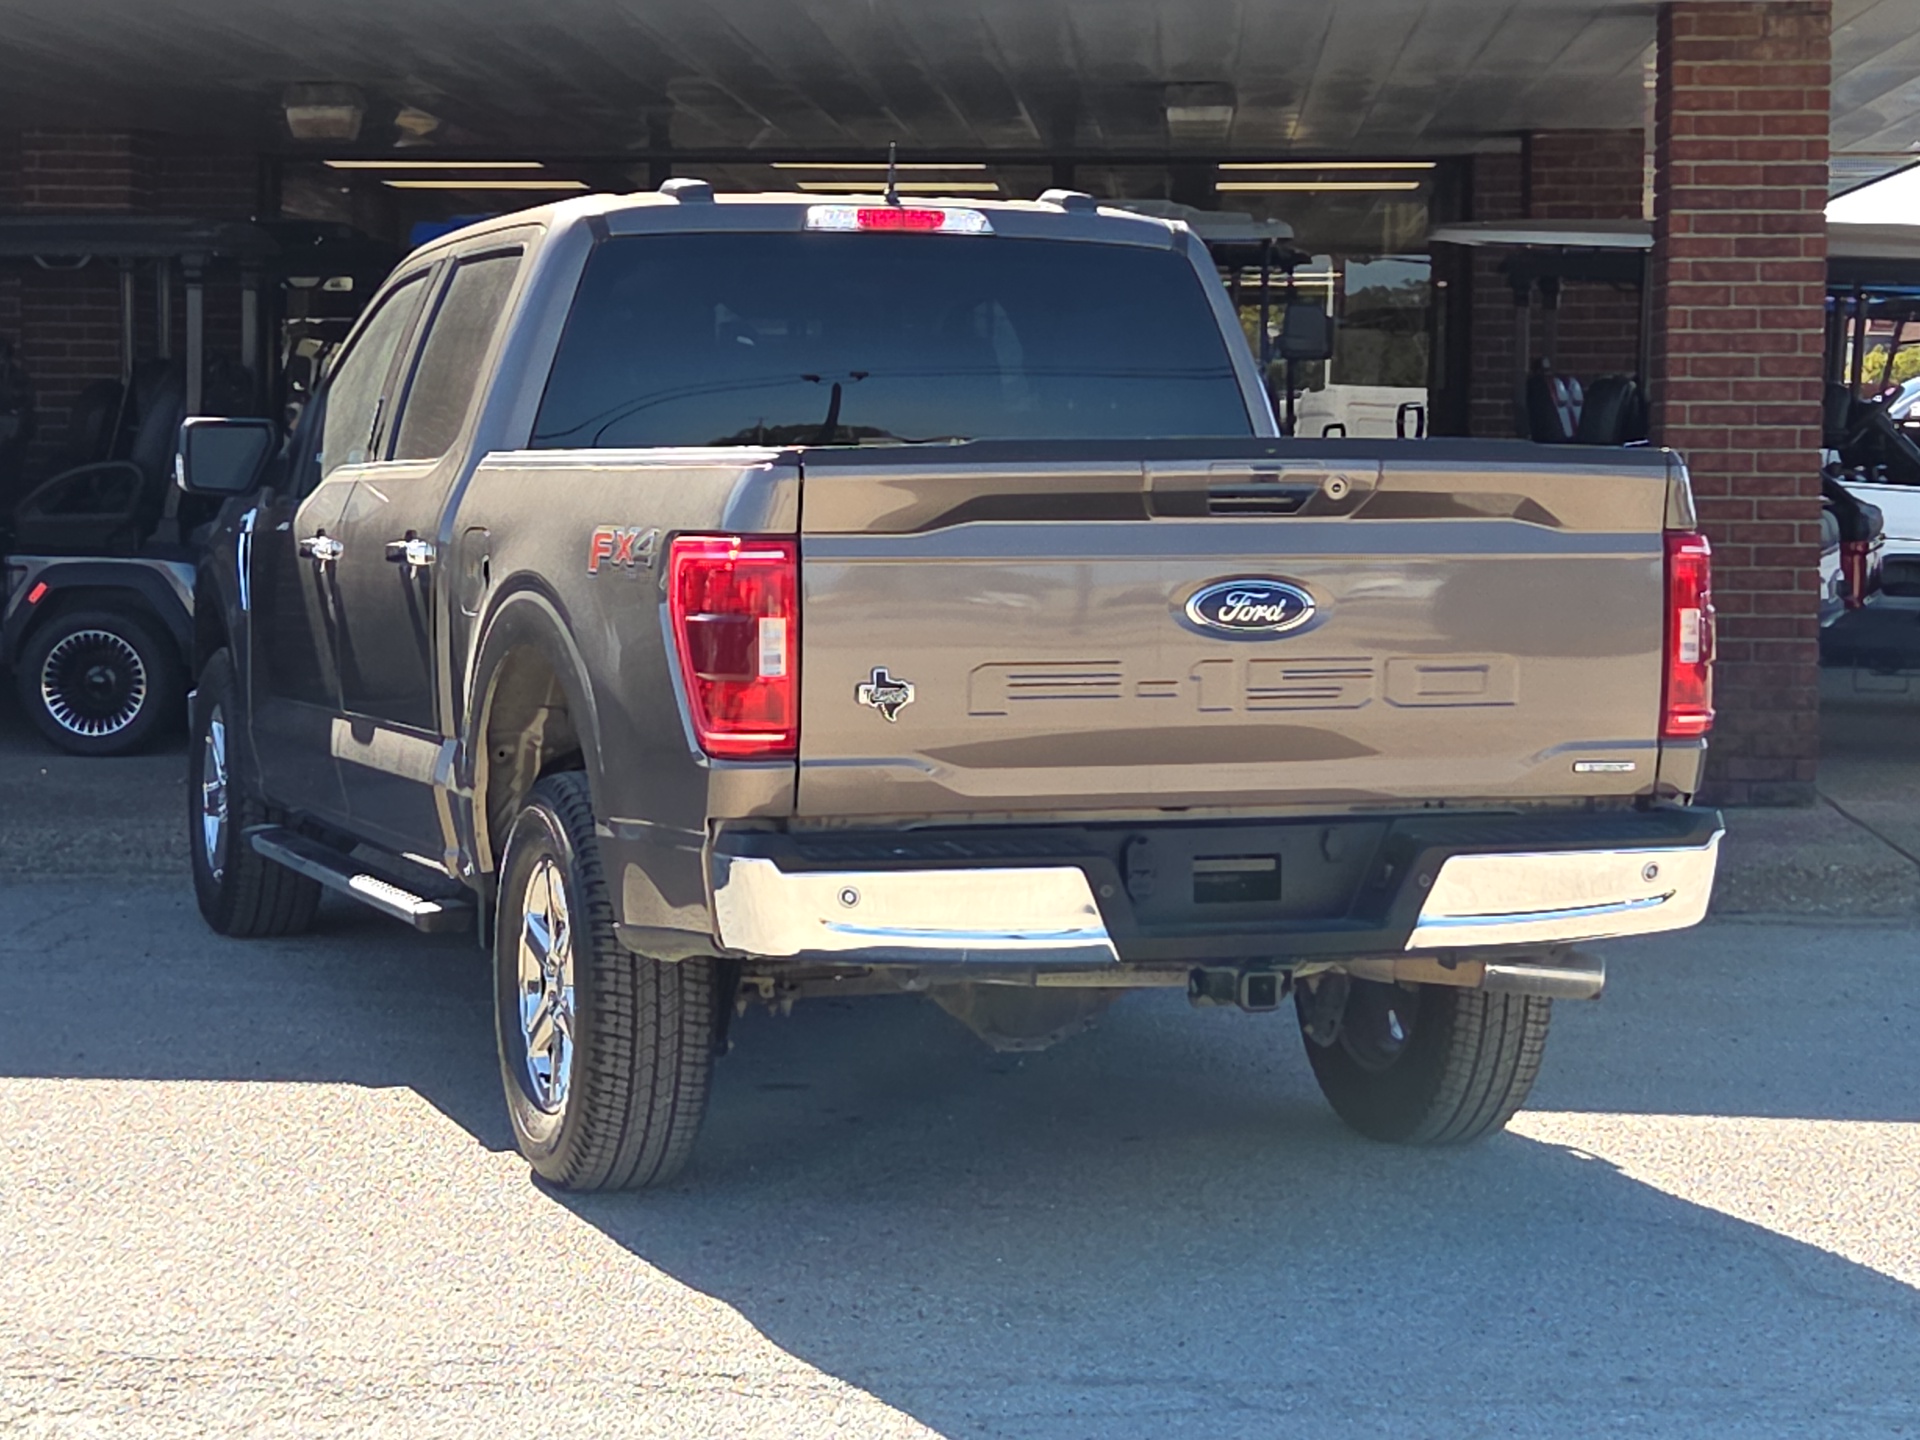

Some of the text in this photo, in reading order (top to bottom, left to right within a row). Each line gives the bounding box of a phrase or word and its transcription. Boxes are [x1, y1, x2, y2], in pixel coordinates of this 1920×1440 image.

[586, 525, 660, 576] FX4
[1218, 591, 1286, 621] Ford
[967, 656, 1518, 716] F-150
